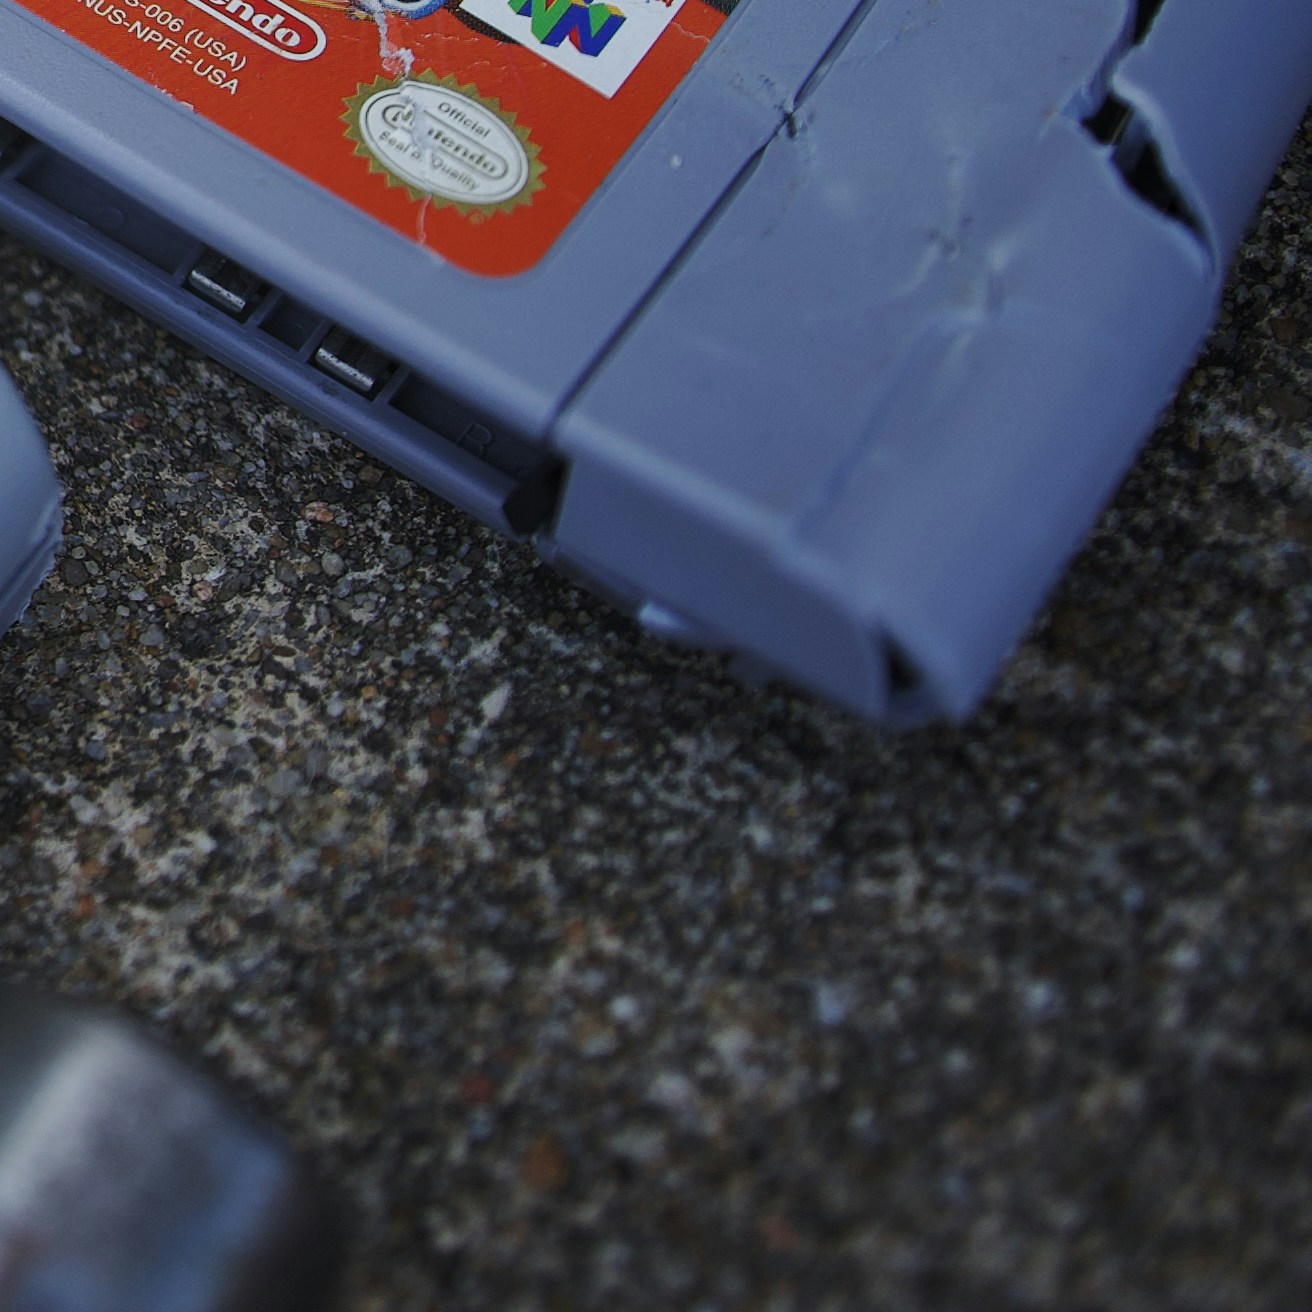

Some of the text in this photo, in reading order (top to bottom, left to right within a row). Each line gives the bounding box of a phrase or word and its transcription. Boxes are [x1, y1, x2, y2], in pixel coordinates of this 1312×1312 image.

[185, 28, 248, 72] (USA)
[438, 101, 492, 138] Official
[379, 131, 410, 154] Seal
[431, 156, 481, 192] Quality
